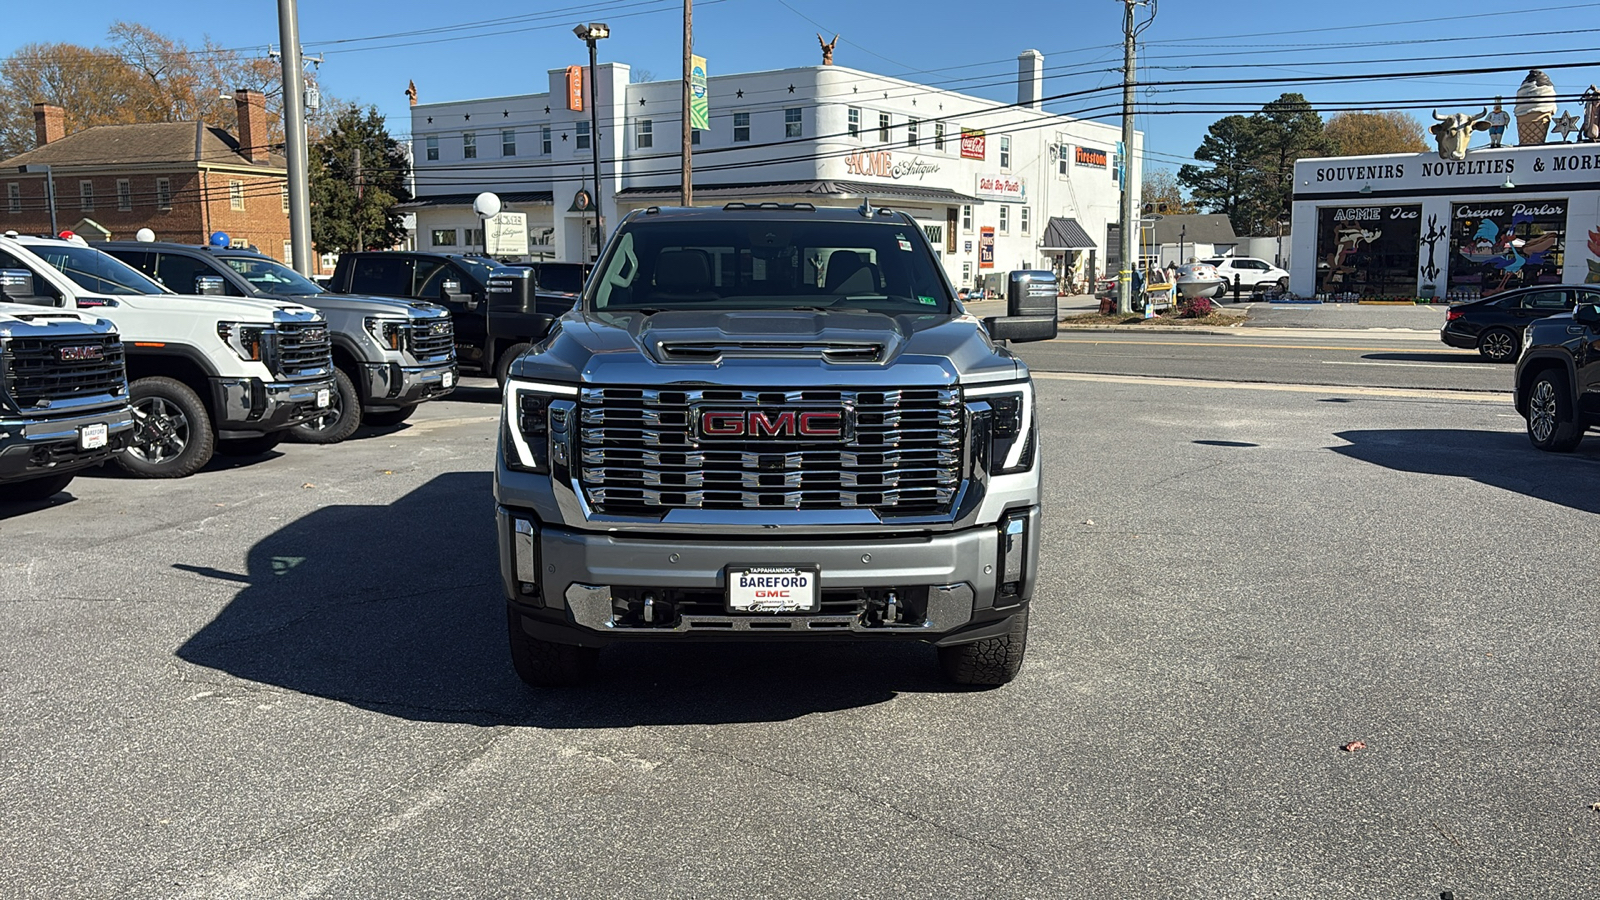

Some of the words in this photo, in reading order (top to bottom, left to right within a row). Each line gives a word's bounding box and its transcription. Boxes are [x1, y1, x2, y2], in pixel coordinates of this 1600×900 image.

[573, 69, 581, 107] ACME
[845, 148, 892, 178] ACME
[892, 156, 941, 181] Antiques
[1076, 147, 1106, 166] Firestone
[1316, 164, 1404, 182] SOUVENIRS
[1421, 159, 1515, 177] NOVELTIES
[1533, 157, 1545, 172] &
[1552, 154, 1600, 171] MORE
[1334, 208, 1381, 221] ACME
[1390, 207, 1418, 219] Ice
[1456, 205, 1505, 219] Cream
[1512, 203, 1564, 216] Parlor
[61, 347, 104, 361] GMC
[702, 411, 842, 436] GMC
[740, 577, 808, 588] BAREFORD
[748, 603, 799, 614] Bareford
